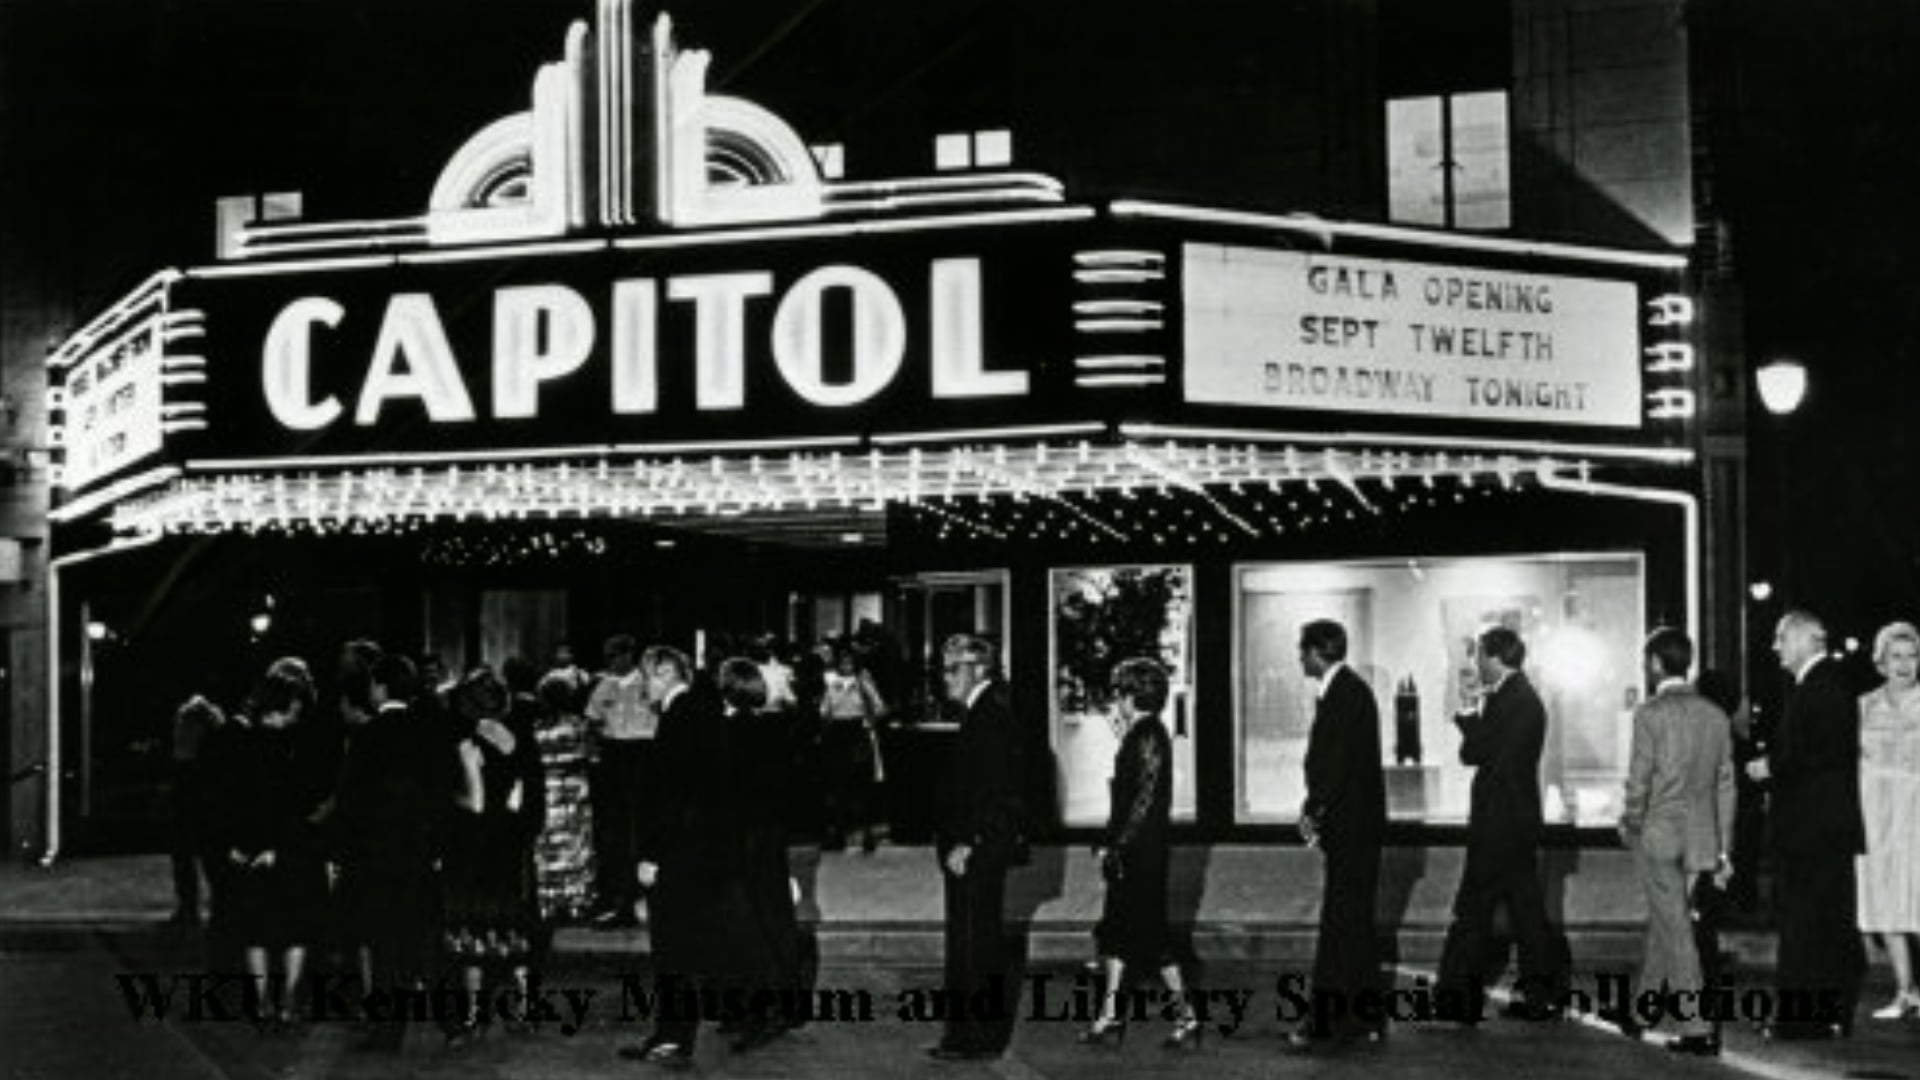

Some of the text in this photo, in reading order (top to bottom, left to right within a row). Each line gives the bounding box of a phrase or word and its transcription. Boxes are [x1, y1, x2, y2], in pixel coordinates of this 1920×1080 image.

[1307, 265, 1553, 315] GALA OPENING
[261, 257, 1030, 431] CAPITOL
[1300, 315, 1554, 361] SEPT TWELFTH
[1263, 361, 1589, 411] BROADWAY TONIGHT
